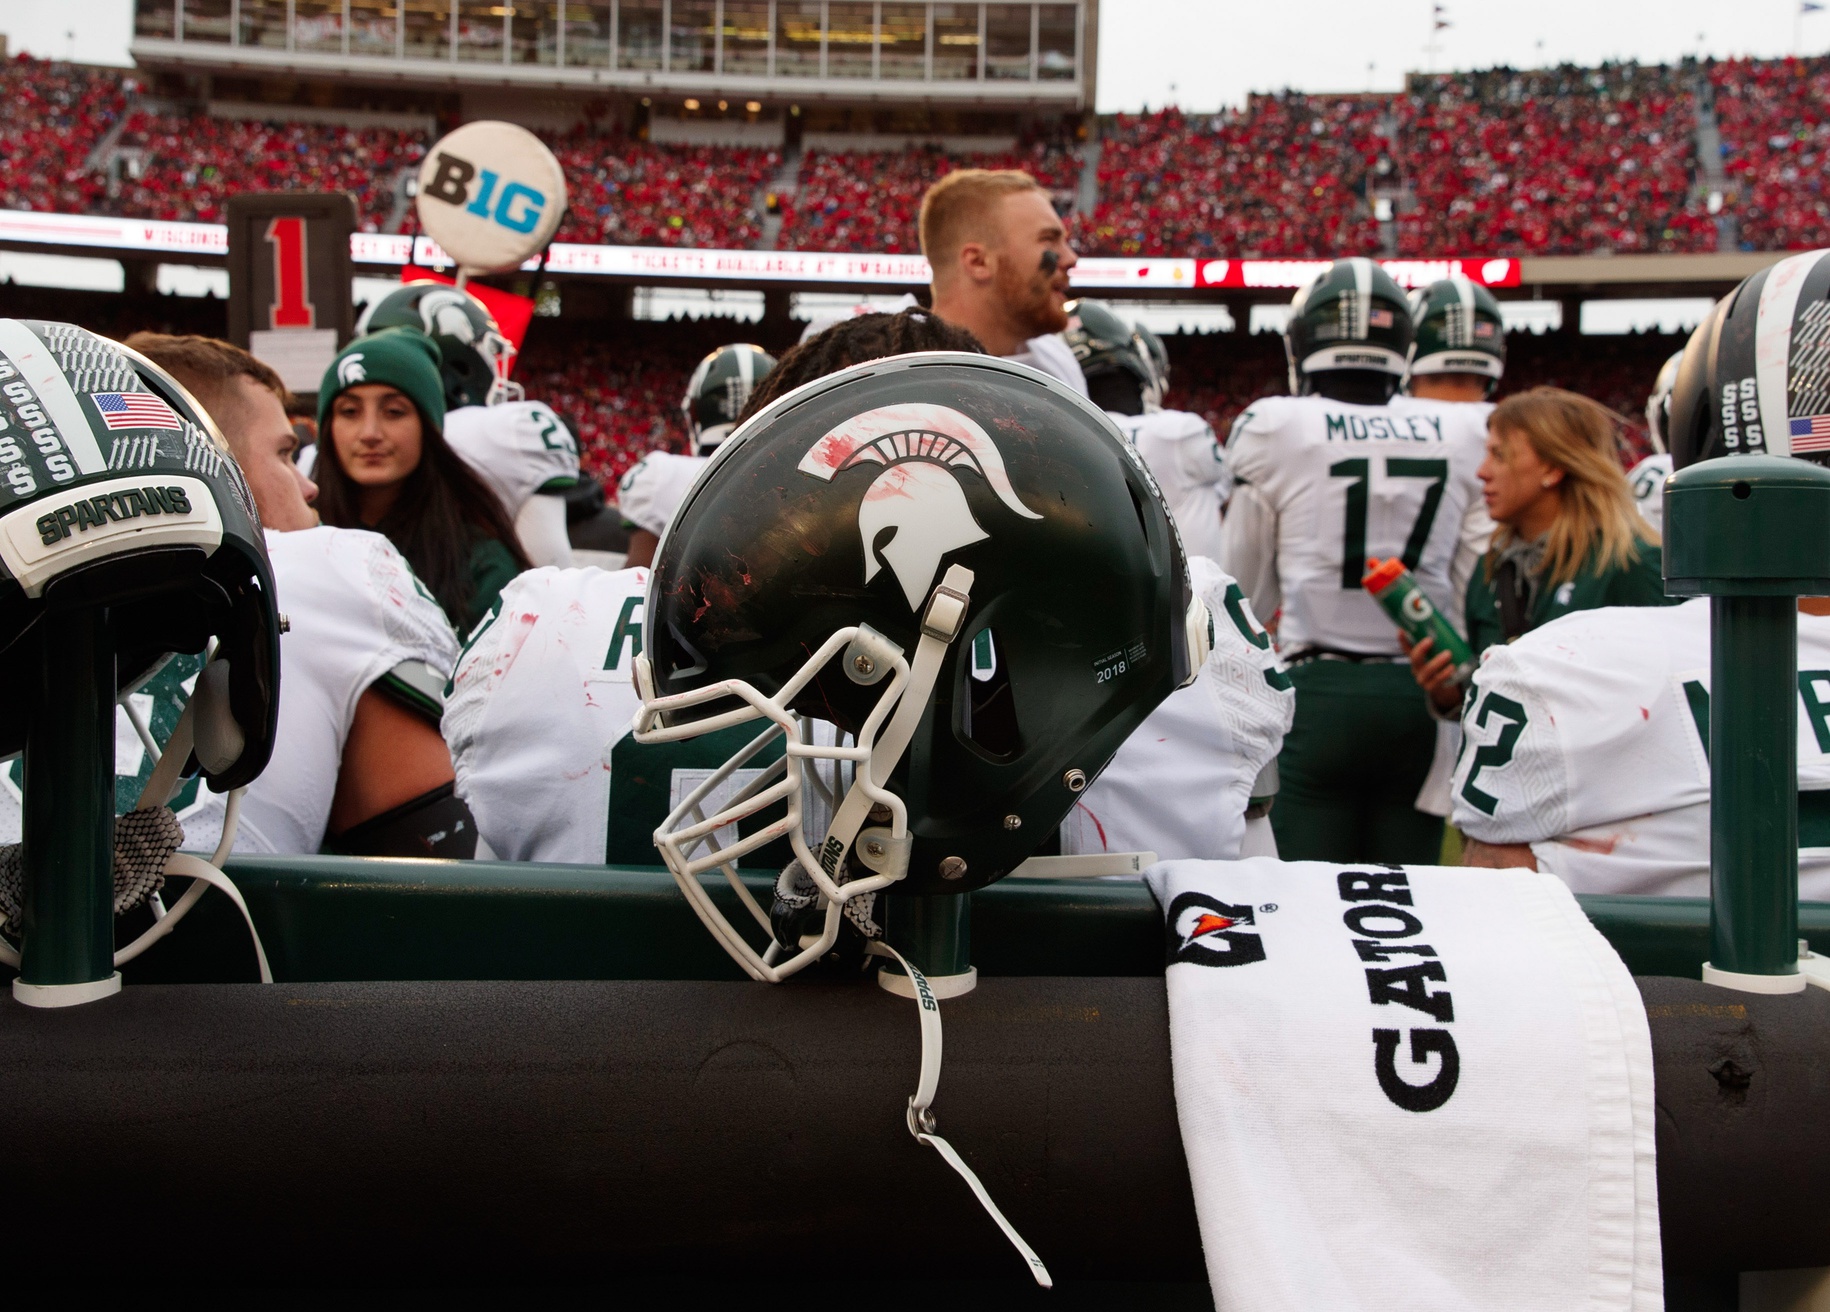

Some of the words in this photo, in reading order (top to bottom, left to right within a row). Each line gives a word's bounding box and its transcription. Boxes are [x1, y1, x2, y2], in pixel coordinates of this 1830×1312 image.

[265, 216, 314, 329] 1
[1325, 412, 1445, 442] MOSLEY
[36, 486, 192, 546] SPARTANS
[1328, 457, 1449, 589] 17
[1096, 660, 1126, 684] 2018
[1336, 863, 1460, 1113] GATOR
